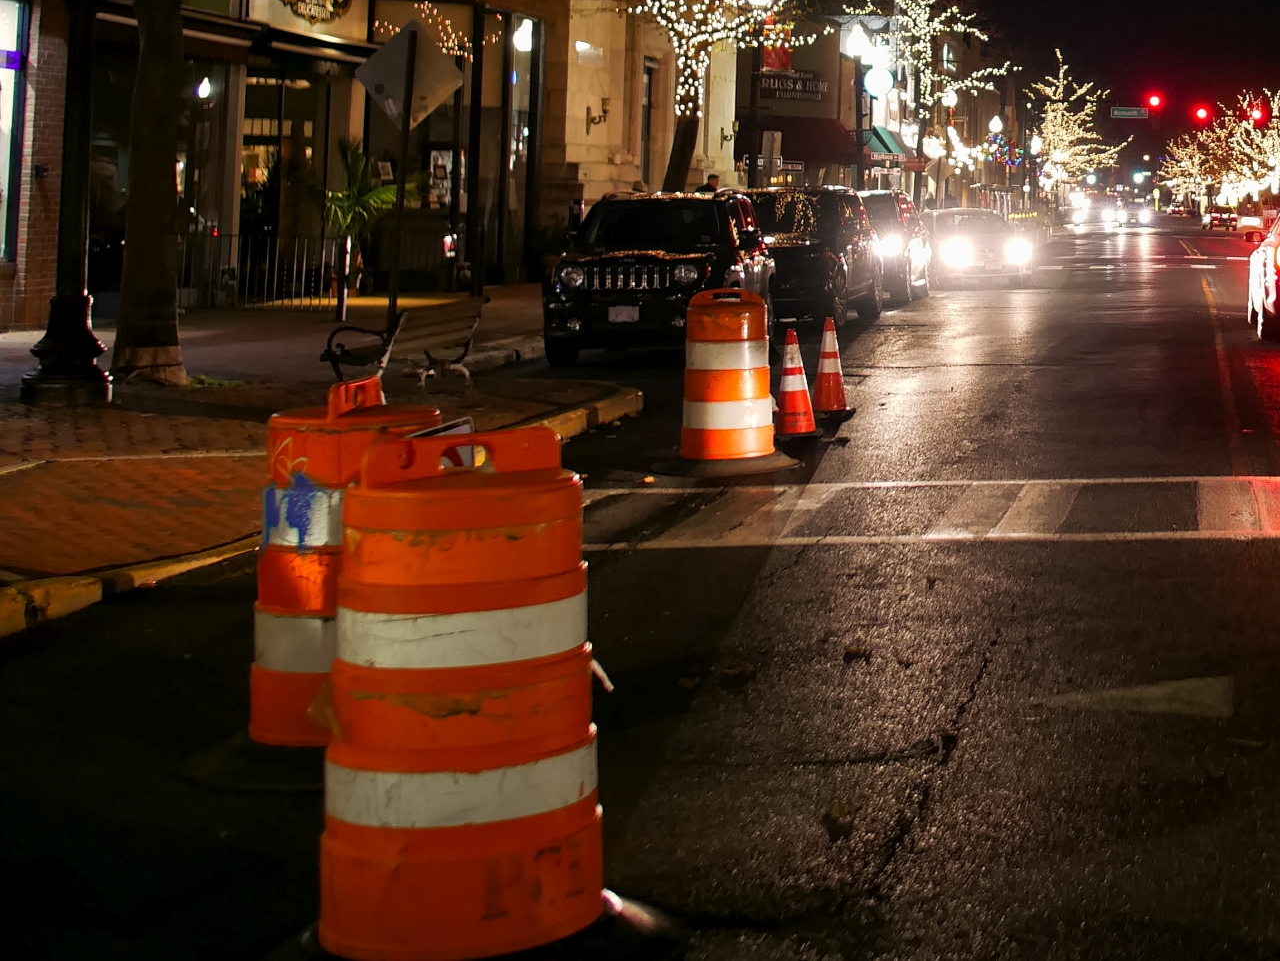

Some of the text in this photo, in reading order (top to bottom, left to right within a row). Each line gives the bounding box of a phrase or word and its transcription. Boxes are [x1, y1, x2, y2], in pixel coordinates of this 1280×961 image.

[761, 78, 829, 92] RUGS & HOME
